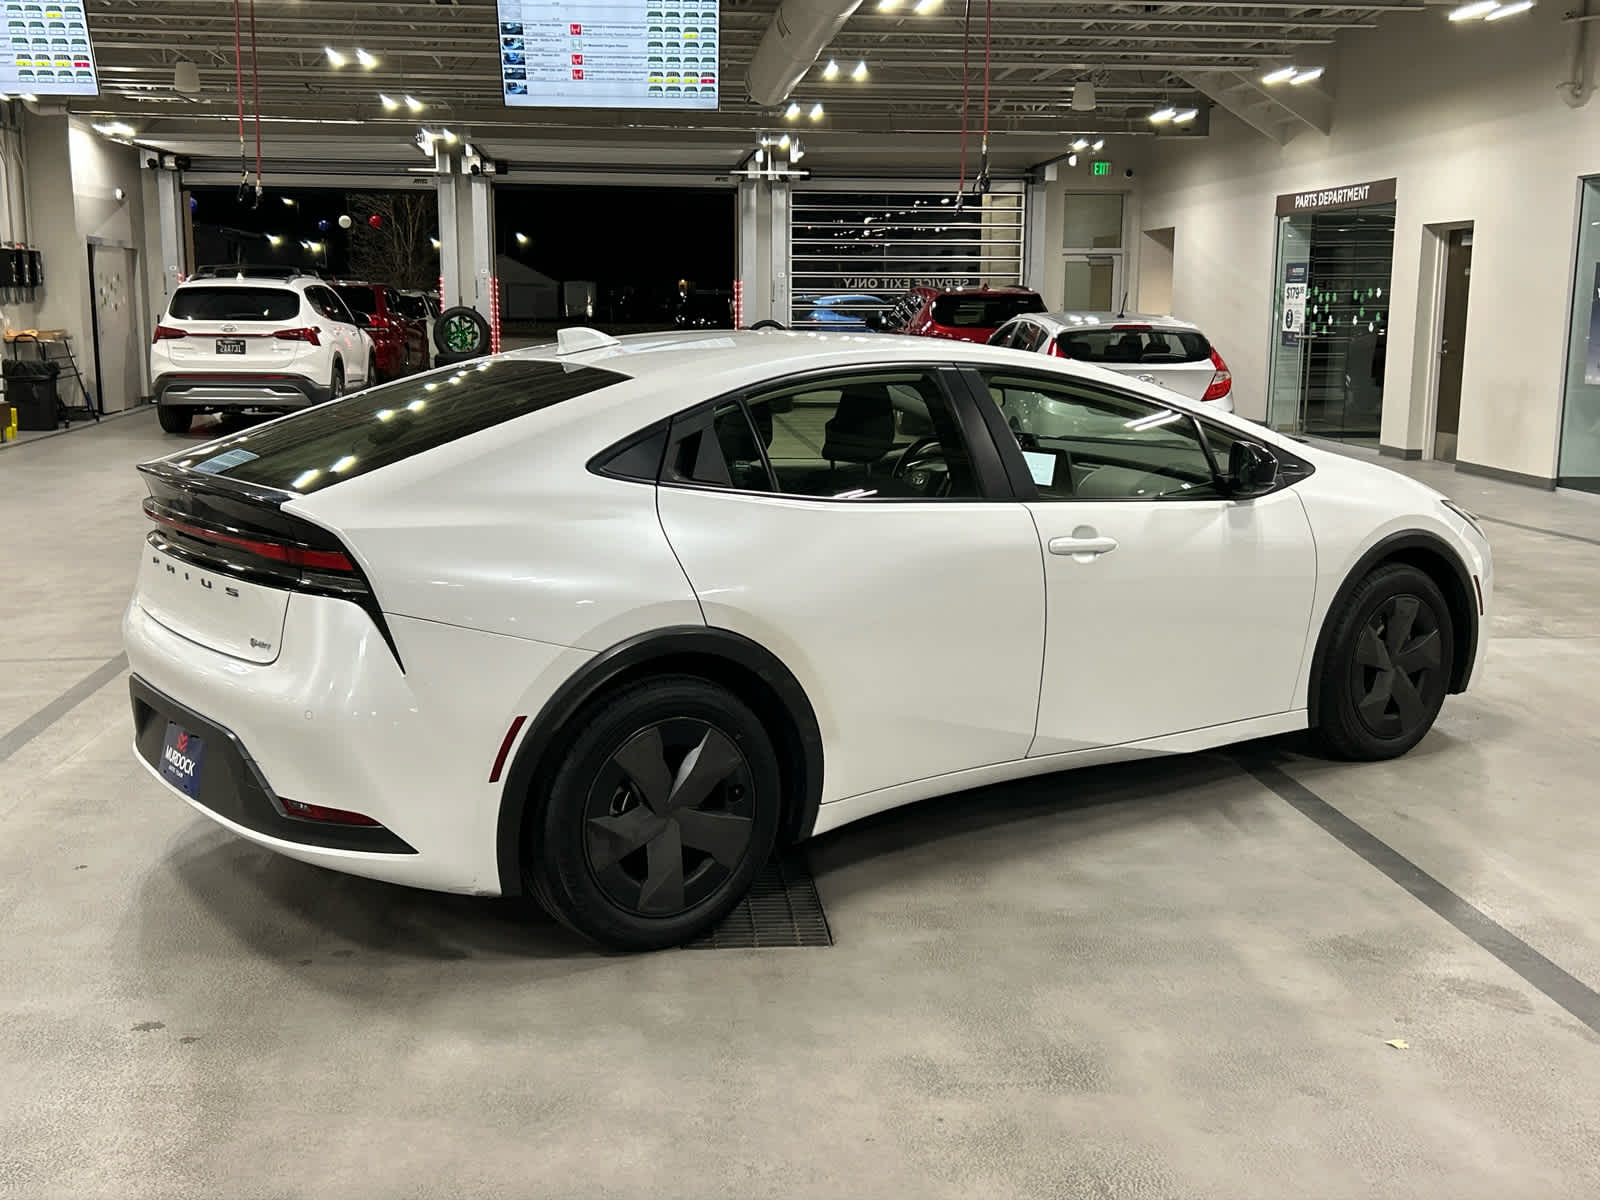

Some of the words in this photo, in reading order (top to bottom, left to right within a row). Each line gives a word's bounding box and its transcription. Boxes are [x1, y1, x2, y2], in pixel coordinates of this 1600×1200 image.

[1295, 193, 1317, 208] PARTS
[1318, 185, 1370, 206] DEPARTMENT
[152, 556, 239, 598] PRIUS
[165, 745, 196, 777] MURDOCK
